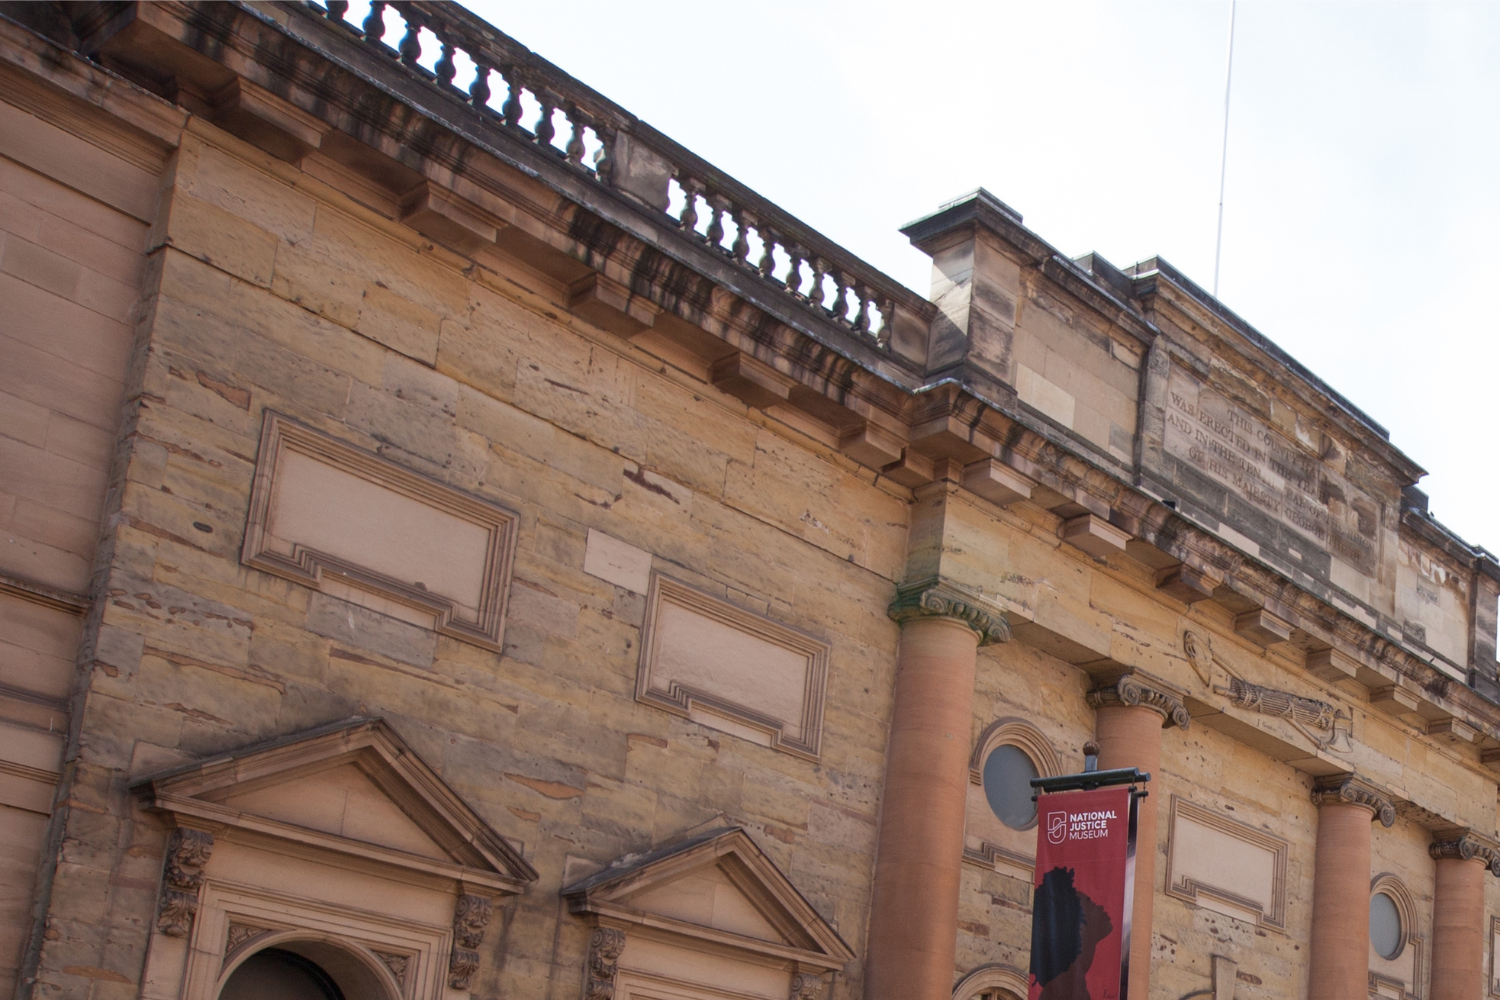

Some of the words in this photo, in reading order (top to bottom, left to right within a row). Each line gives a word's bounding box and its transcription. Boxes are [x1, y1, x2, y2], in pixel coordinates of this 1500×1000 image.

[1170, 391, 1194, 416] WAS
[1199, 410, 1251, 452] ERECTED
[1254, 449, 1267, 463] IN
[1269, 457, 1292, 481] THE
[1227, 409, 1253, 434] THIS
[1256, 430, 1298, 465] COUNTY
[1167, 413, 1192, 435] AND
[1194, 428, 1209, 445] IN
[1212, 440, 1236, 463] THE
[1309, 505, 1323, 519] OF
[1209, 457, 1228, 479] HIS
[1232, 473, 1282, 513] MAJESTY
[1284, 508, 1325, 541] GEORGE
[1069, 810, 1117, 823] NATIONAL
[1069, 819, 1107, 832] JUSTICE
[1069, 829, 1109, 841] MUSEUM
